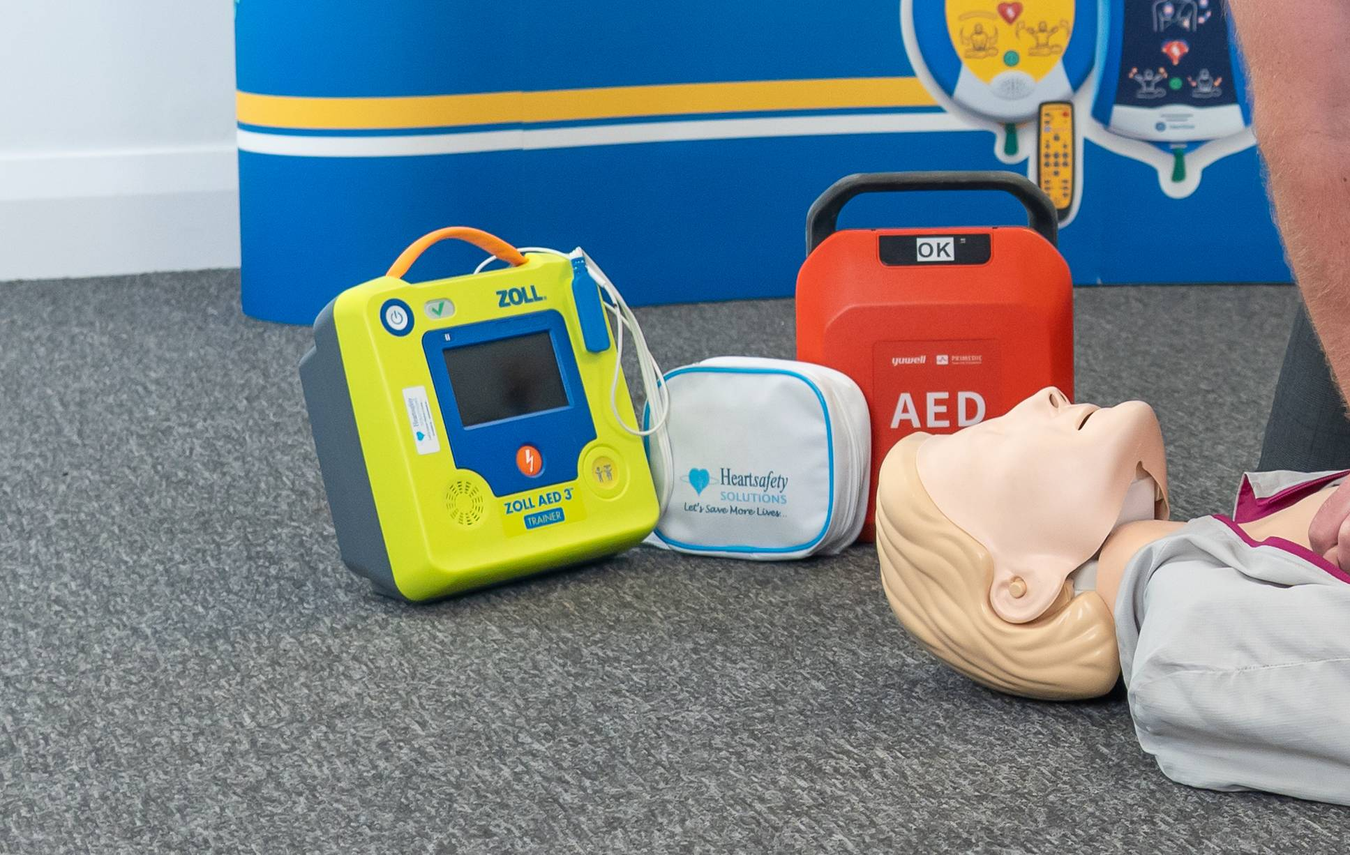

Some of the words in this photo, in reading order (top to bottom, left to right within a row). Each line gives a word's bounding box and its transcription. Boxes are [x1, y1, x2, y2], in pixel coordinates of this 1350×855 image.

[918, 242, 951, 258] OK
[496, 285, 544, 308] ZOLL
[892, 355, 926, 366] yuwell
[890, 391, 986, 428] AED
[720, 467, 788, 493] Heartsafety
[504, 497, 535, 514] ZOLL
[538, 491, 562, 507] AED
[720, 491, 787, 504] SOLUTIONS
[684, 502, 704, 513] Let's
[705, 504, 729, 514] Save
[729, 505, 755, 515] More
[527, 511, 561, 527] TRAINER
